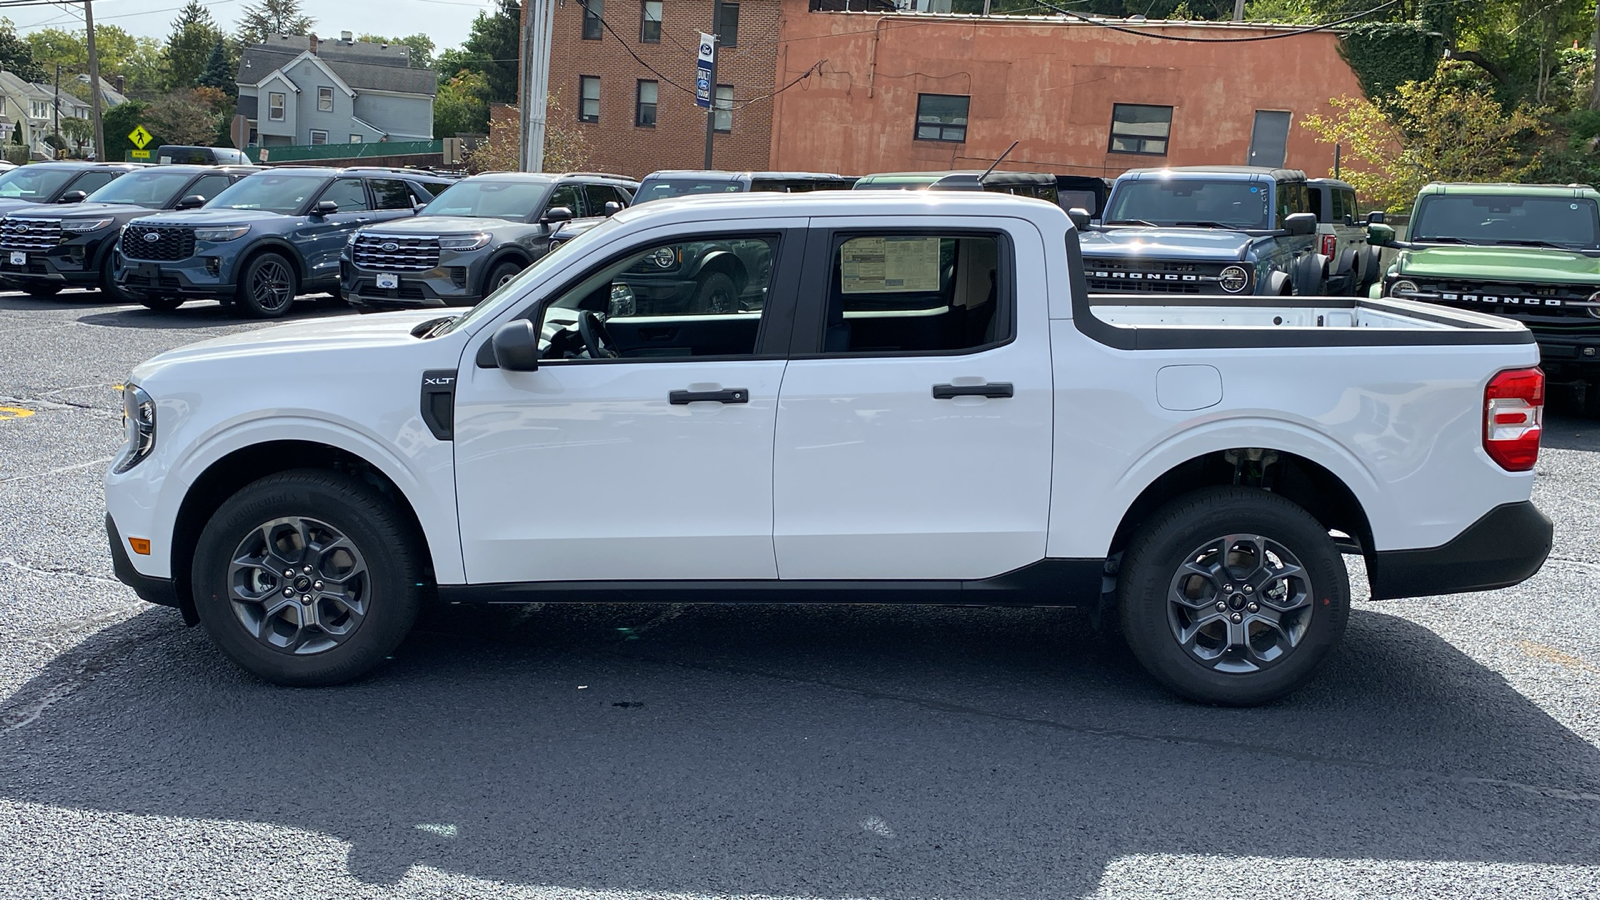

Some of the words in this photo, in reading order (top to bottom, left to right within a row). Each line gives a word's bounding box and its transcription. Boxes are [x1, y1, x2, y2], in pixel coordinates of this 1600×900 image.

[1095, 271, 1196, 281] BRONCO
[1442, 293, 1561, 306] BRONCO
[424, 377, 455, 385] XLT
[227, 492, 287, 527] Continental
